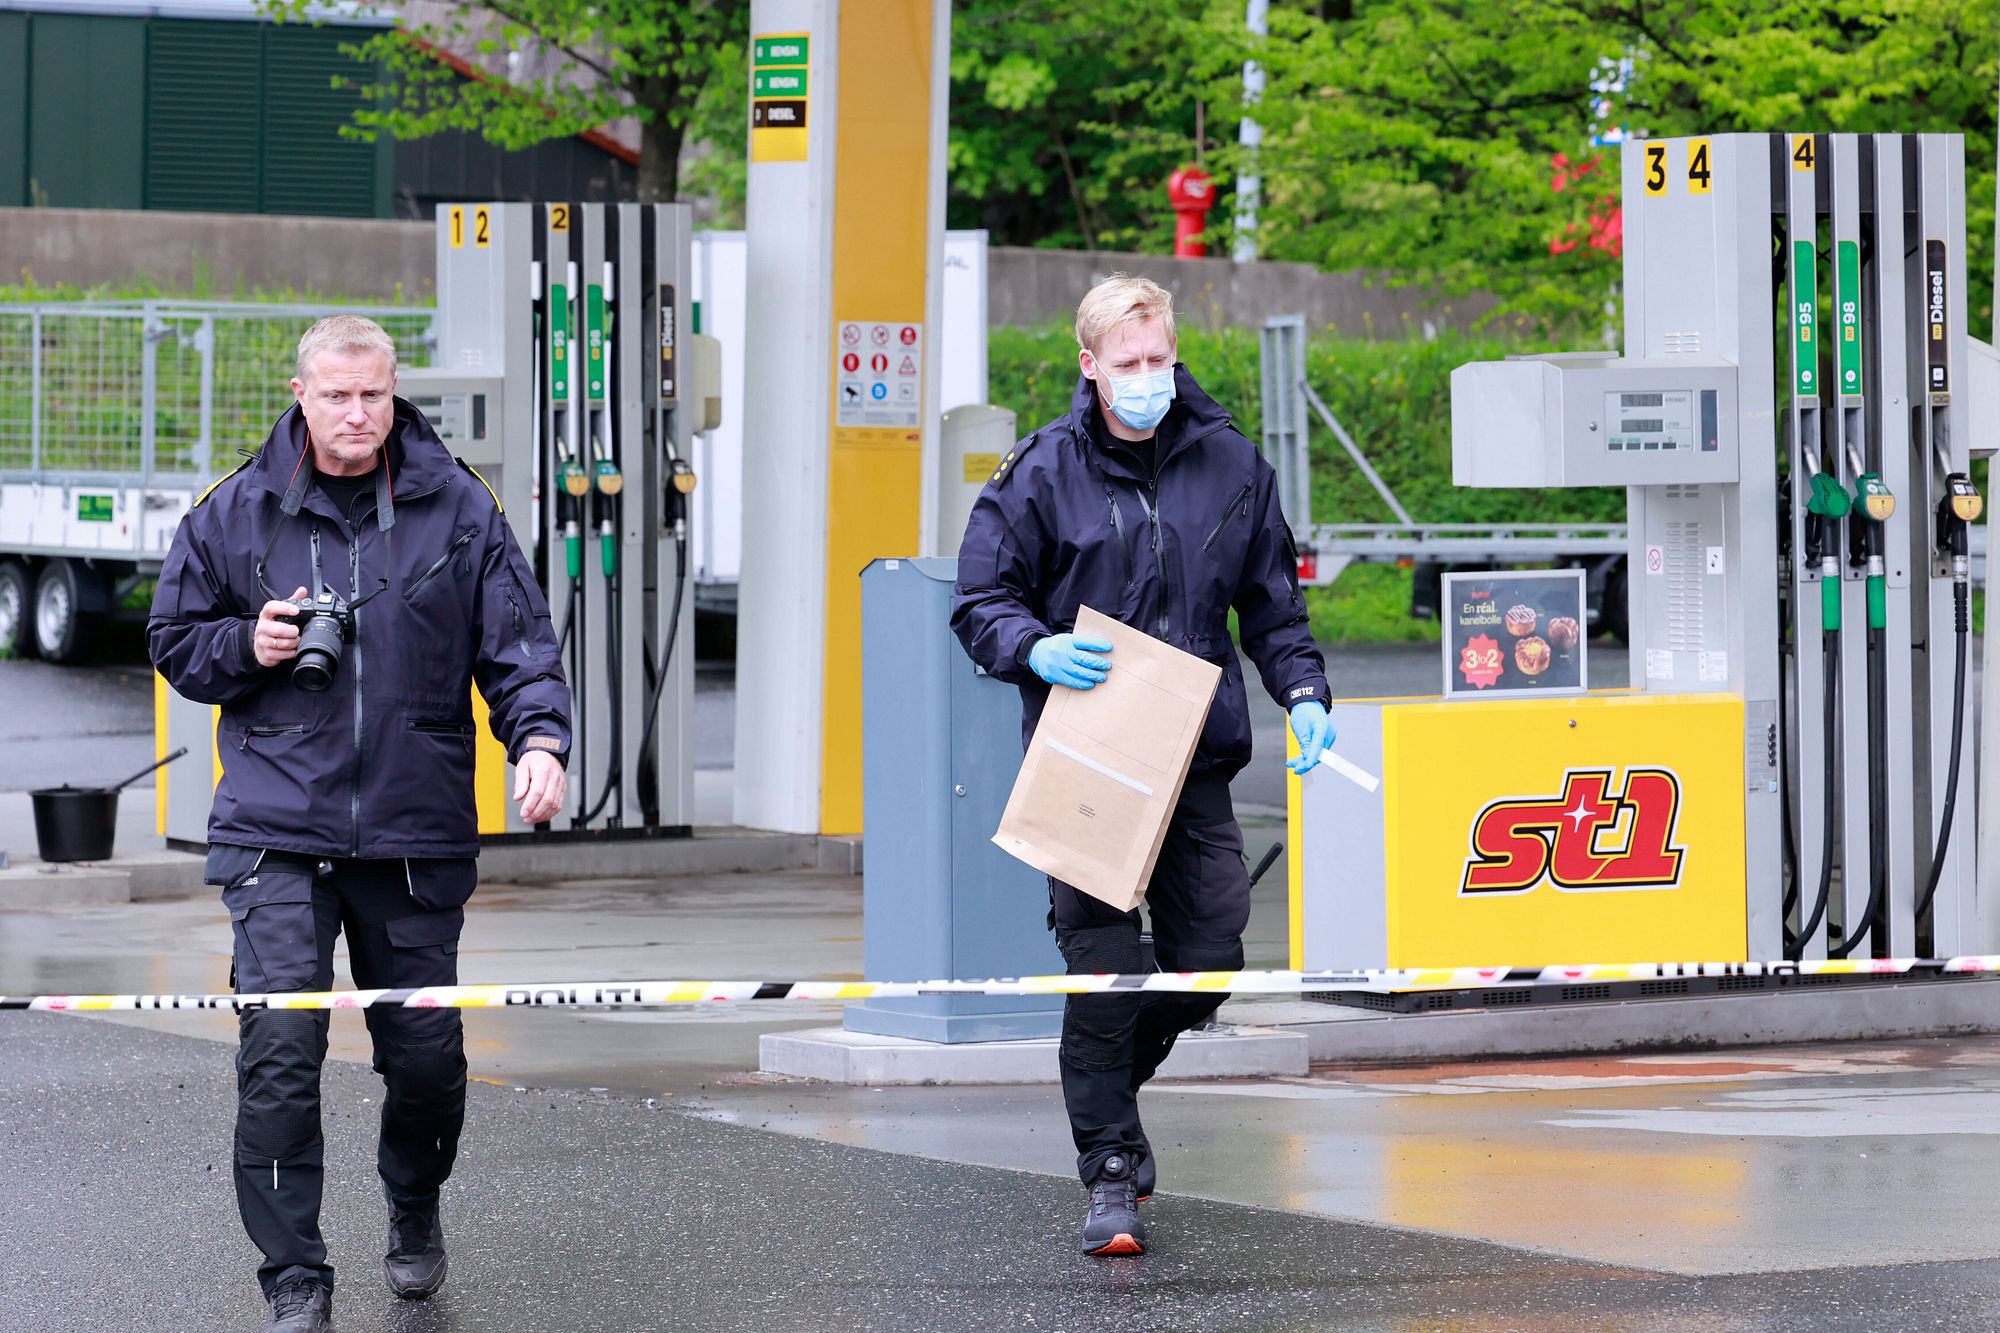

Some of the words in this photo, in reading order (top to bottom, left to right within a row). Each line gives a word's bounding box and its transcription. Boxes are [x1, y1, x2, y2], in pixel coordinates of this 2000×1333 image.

[1793, 138, 1815, 168] 4
[1647, 147, 1666, 192] 3
[1688, 144, 1711, 189] 4
[453, 211, 462, 244] 1
[477, 211, 489, 243] 2
[552, 208, 567, 230] 2
[1929, 270, 1944, 323] Diesel
[1798, 302, 1812, 324] 95
[1843, 301, 1856, 324] 98
[661, 306, 674, 347] Diesel
[1463, 603, 1475, 614] En
[1459, 615, 1502, 626] kanelbolle
[1465, 649, 1478, 669] 3
[1478, 654, 1489, 664] for
[1486, 648, 1499, 668] 2
[1301, 686, 1315, 696] 112
[1460, 768, 1685, 893] st1
